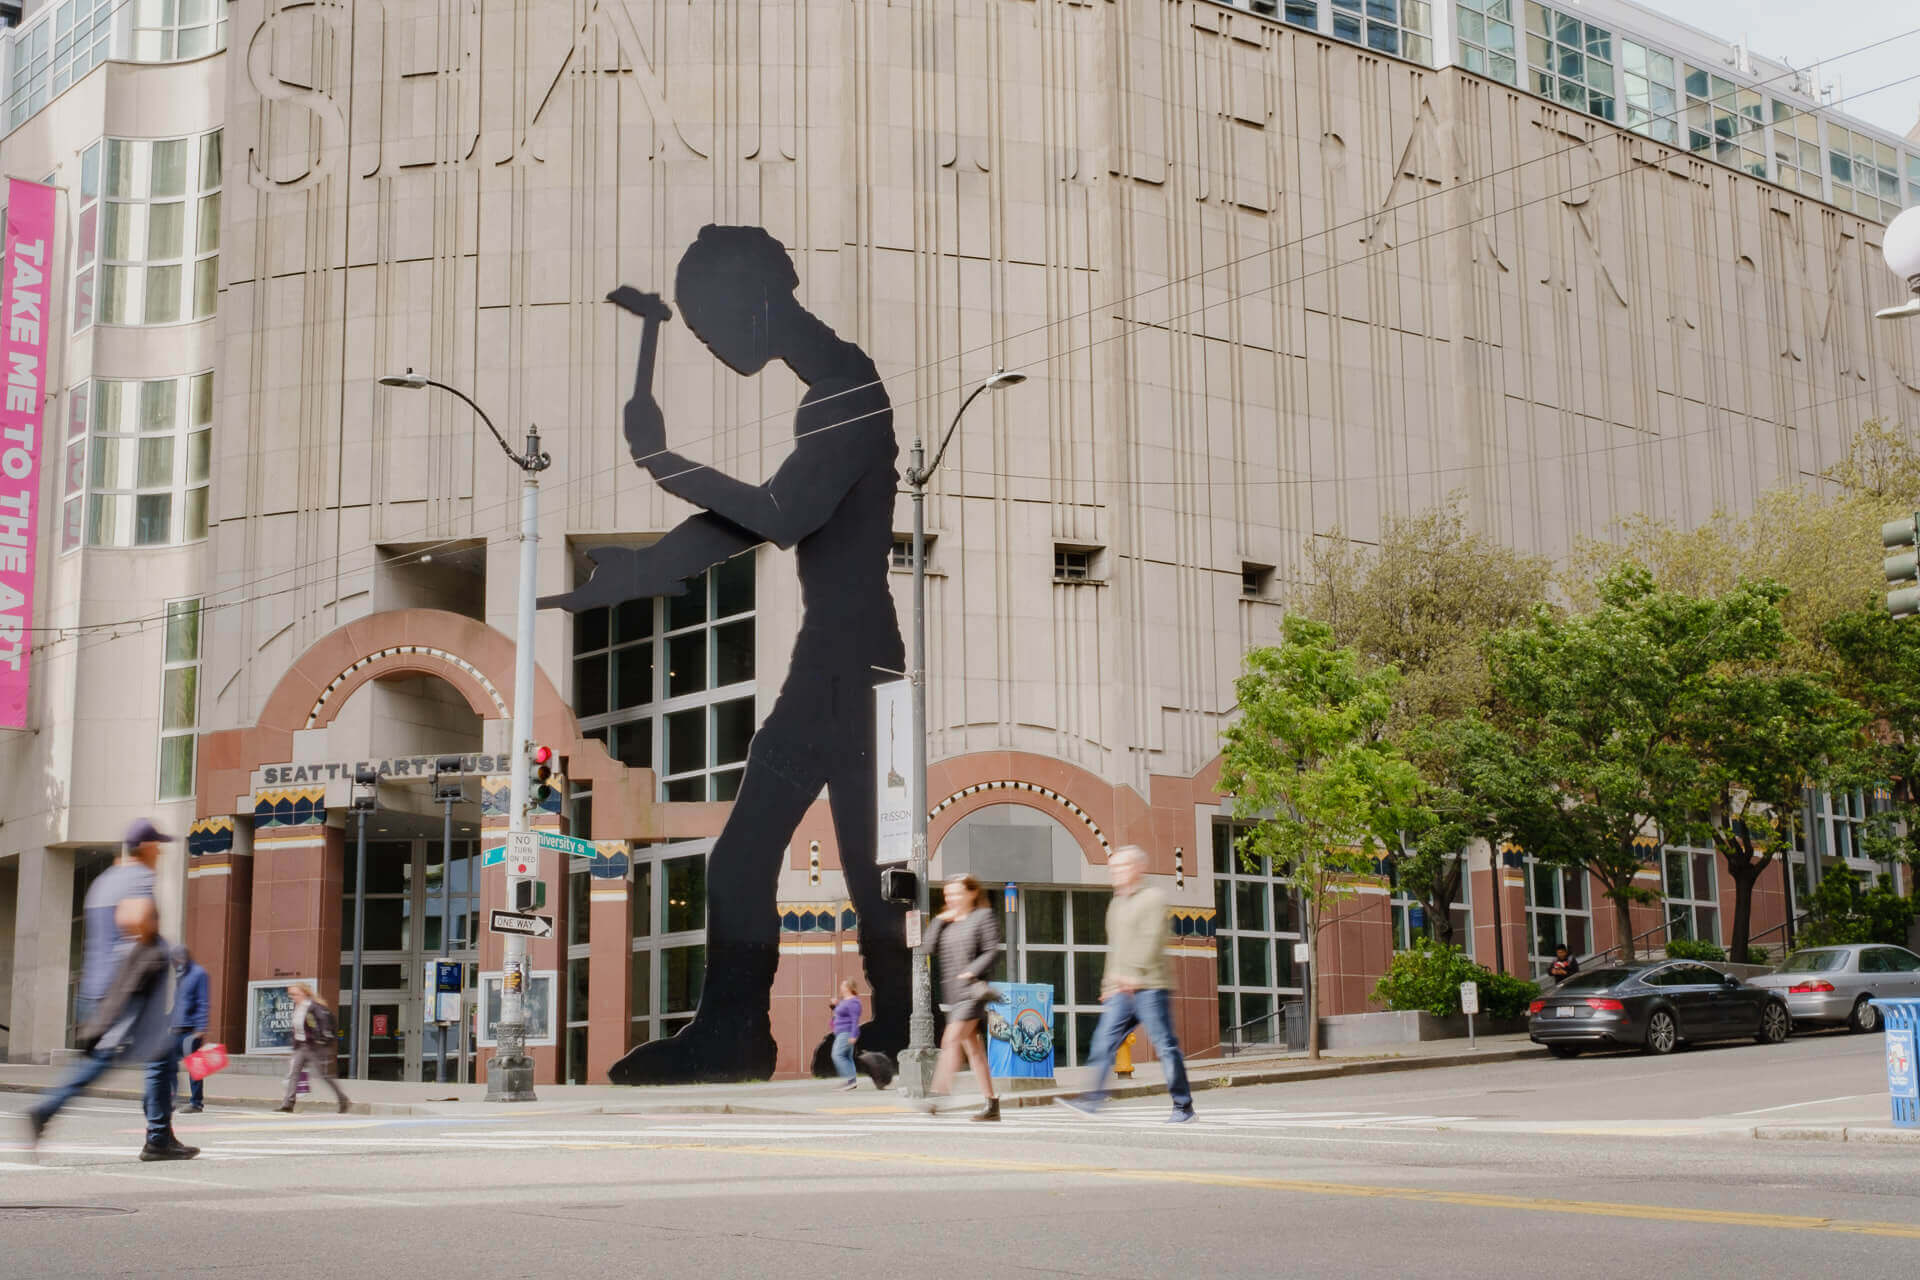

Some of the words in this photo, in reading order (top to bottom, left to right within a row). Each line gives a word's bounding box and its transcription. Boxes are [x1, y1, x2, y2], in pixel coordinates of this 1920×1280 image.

[9, 238, 45, 346] TAKE
[5, 351, 38, 415] ME
[2, 423, 35, 480] TO
[0, 489, 30, 574] THE
[0, 580, 25, 672] ART
[378, 758, 427, 777] ART
[880, 809, 912, 823] FRISSON
[513, 846, 533, 854] TURN
[515, 836, 531, 845] NO
[539, 834, 576, 853] niversity
[510, 855, 520, 864] ON
[522, 855, 536, 864] RED
[496, 917, 514, 928] ONE
[516, 919, 535, 930] WAY
